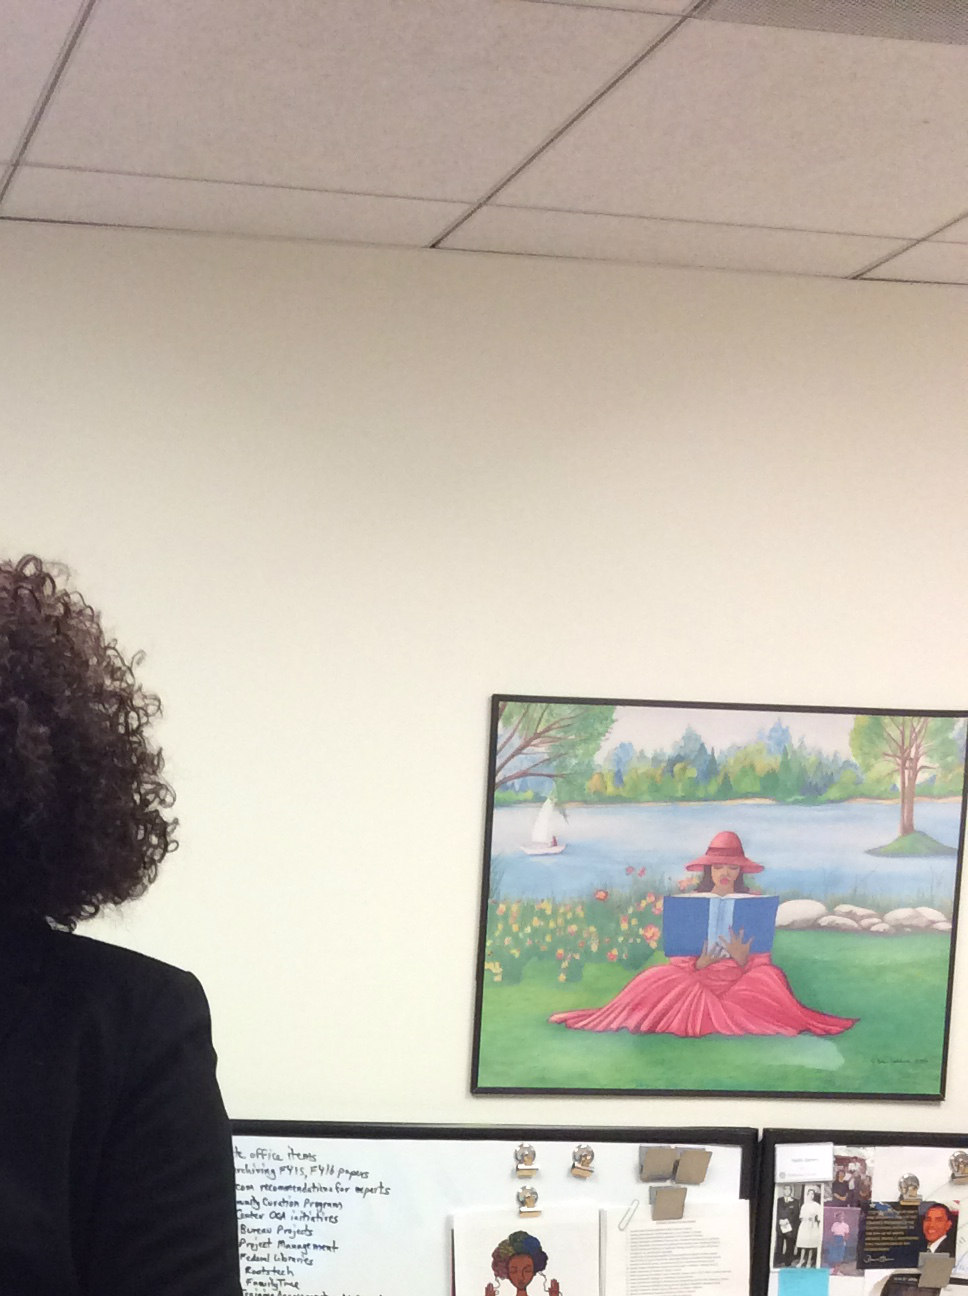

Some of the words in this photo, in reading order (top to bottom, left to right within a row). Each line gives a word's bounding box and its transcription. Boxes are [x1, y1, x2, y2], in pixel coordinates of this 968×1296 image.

[249, 1147, 284, 1162] office
[287, 1145, 318, 1162] items
[337, 1165, 370, 1180] papers
[334, 1181, 350, 1194] for
[240, 1223, 272, 1236] Bureau
[276, 1223, 314, 1239] Projects
[238, 1236, 273, 1251] Project
[277, 1239, 339, 1256] Management
[240, 1252, 270, 1263] Federal
